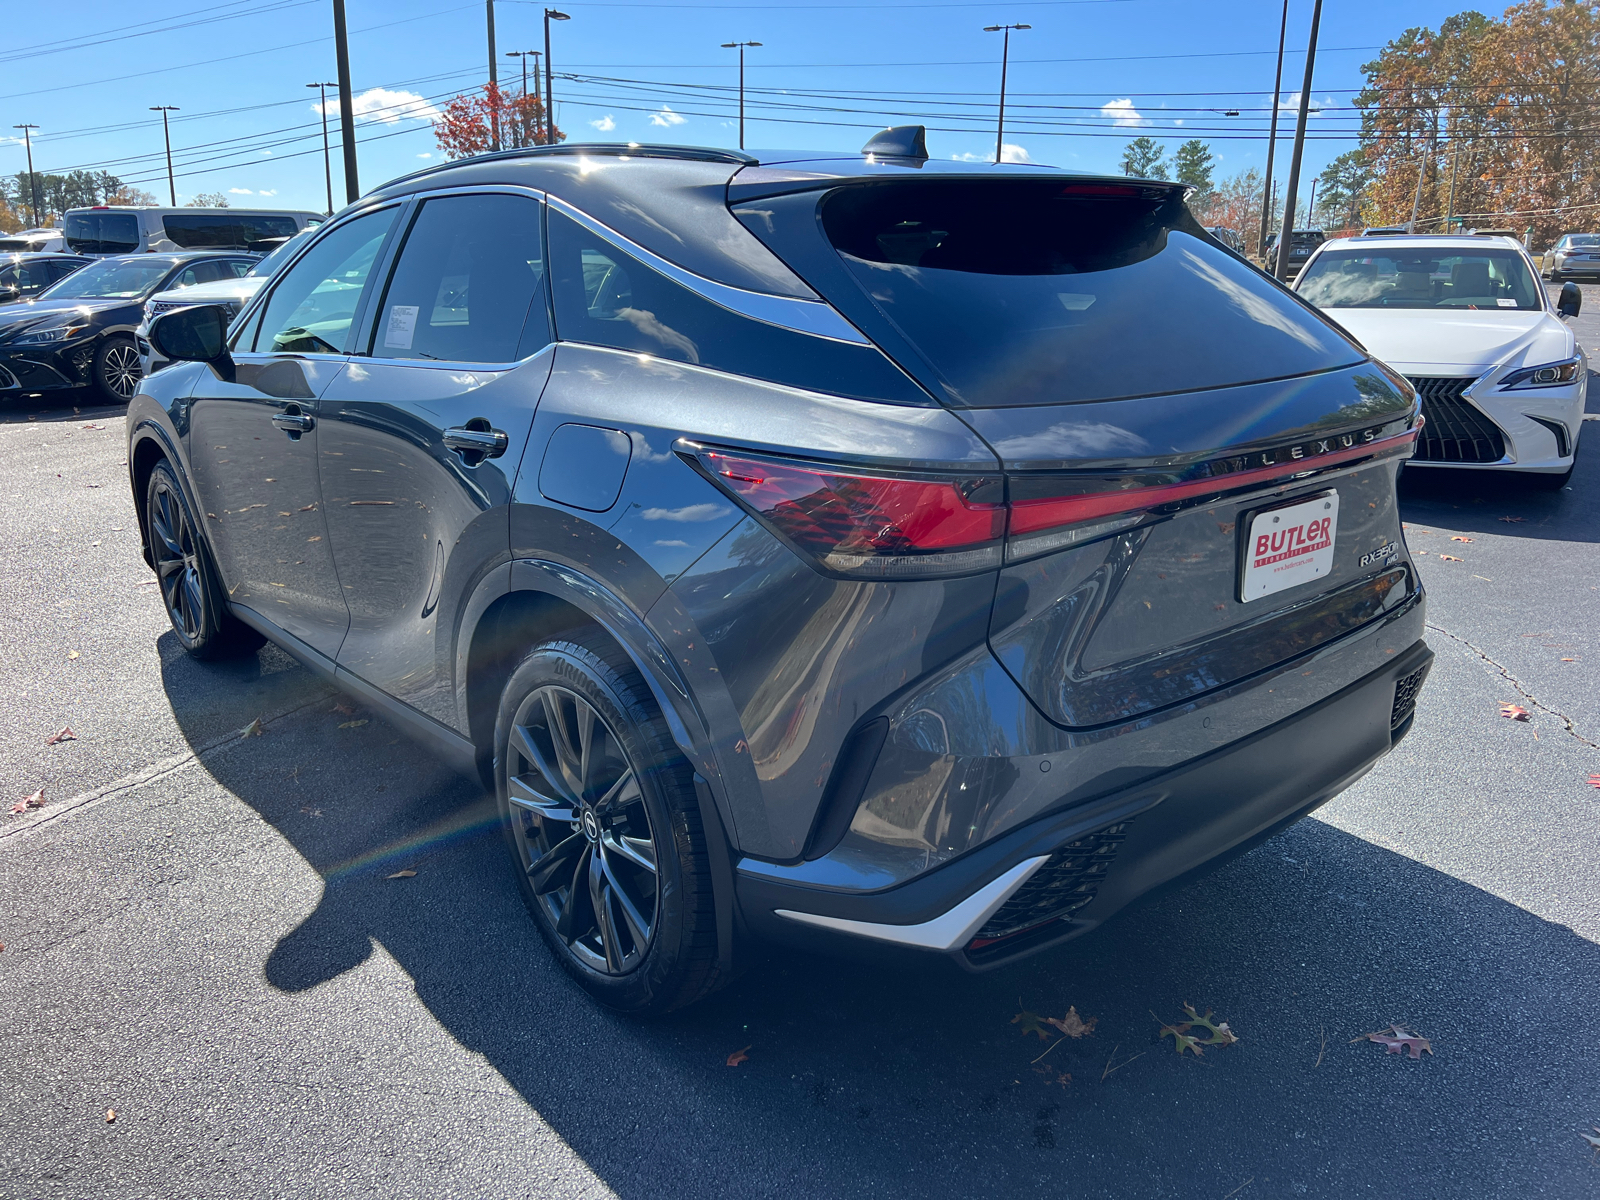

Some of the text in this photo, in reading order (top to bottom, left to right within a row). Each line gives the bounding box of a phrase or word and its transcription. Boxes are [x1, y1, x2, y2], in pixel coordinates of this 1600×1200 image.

[1262, 429, 1375, 466] LEXUS
[1254, 540, 1331, 568] AUTOMOTIVE GROUP
[1273, 557, 1314, 573] www.butlercars.com
[1385, 552, 1399, 566] AWD
[554, 656, 645, 761] BRIDGESTONE
